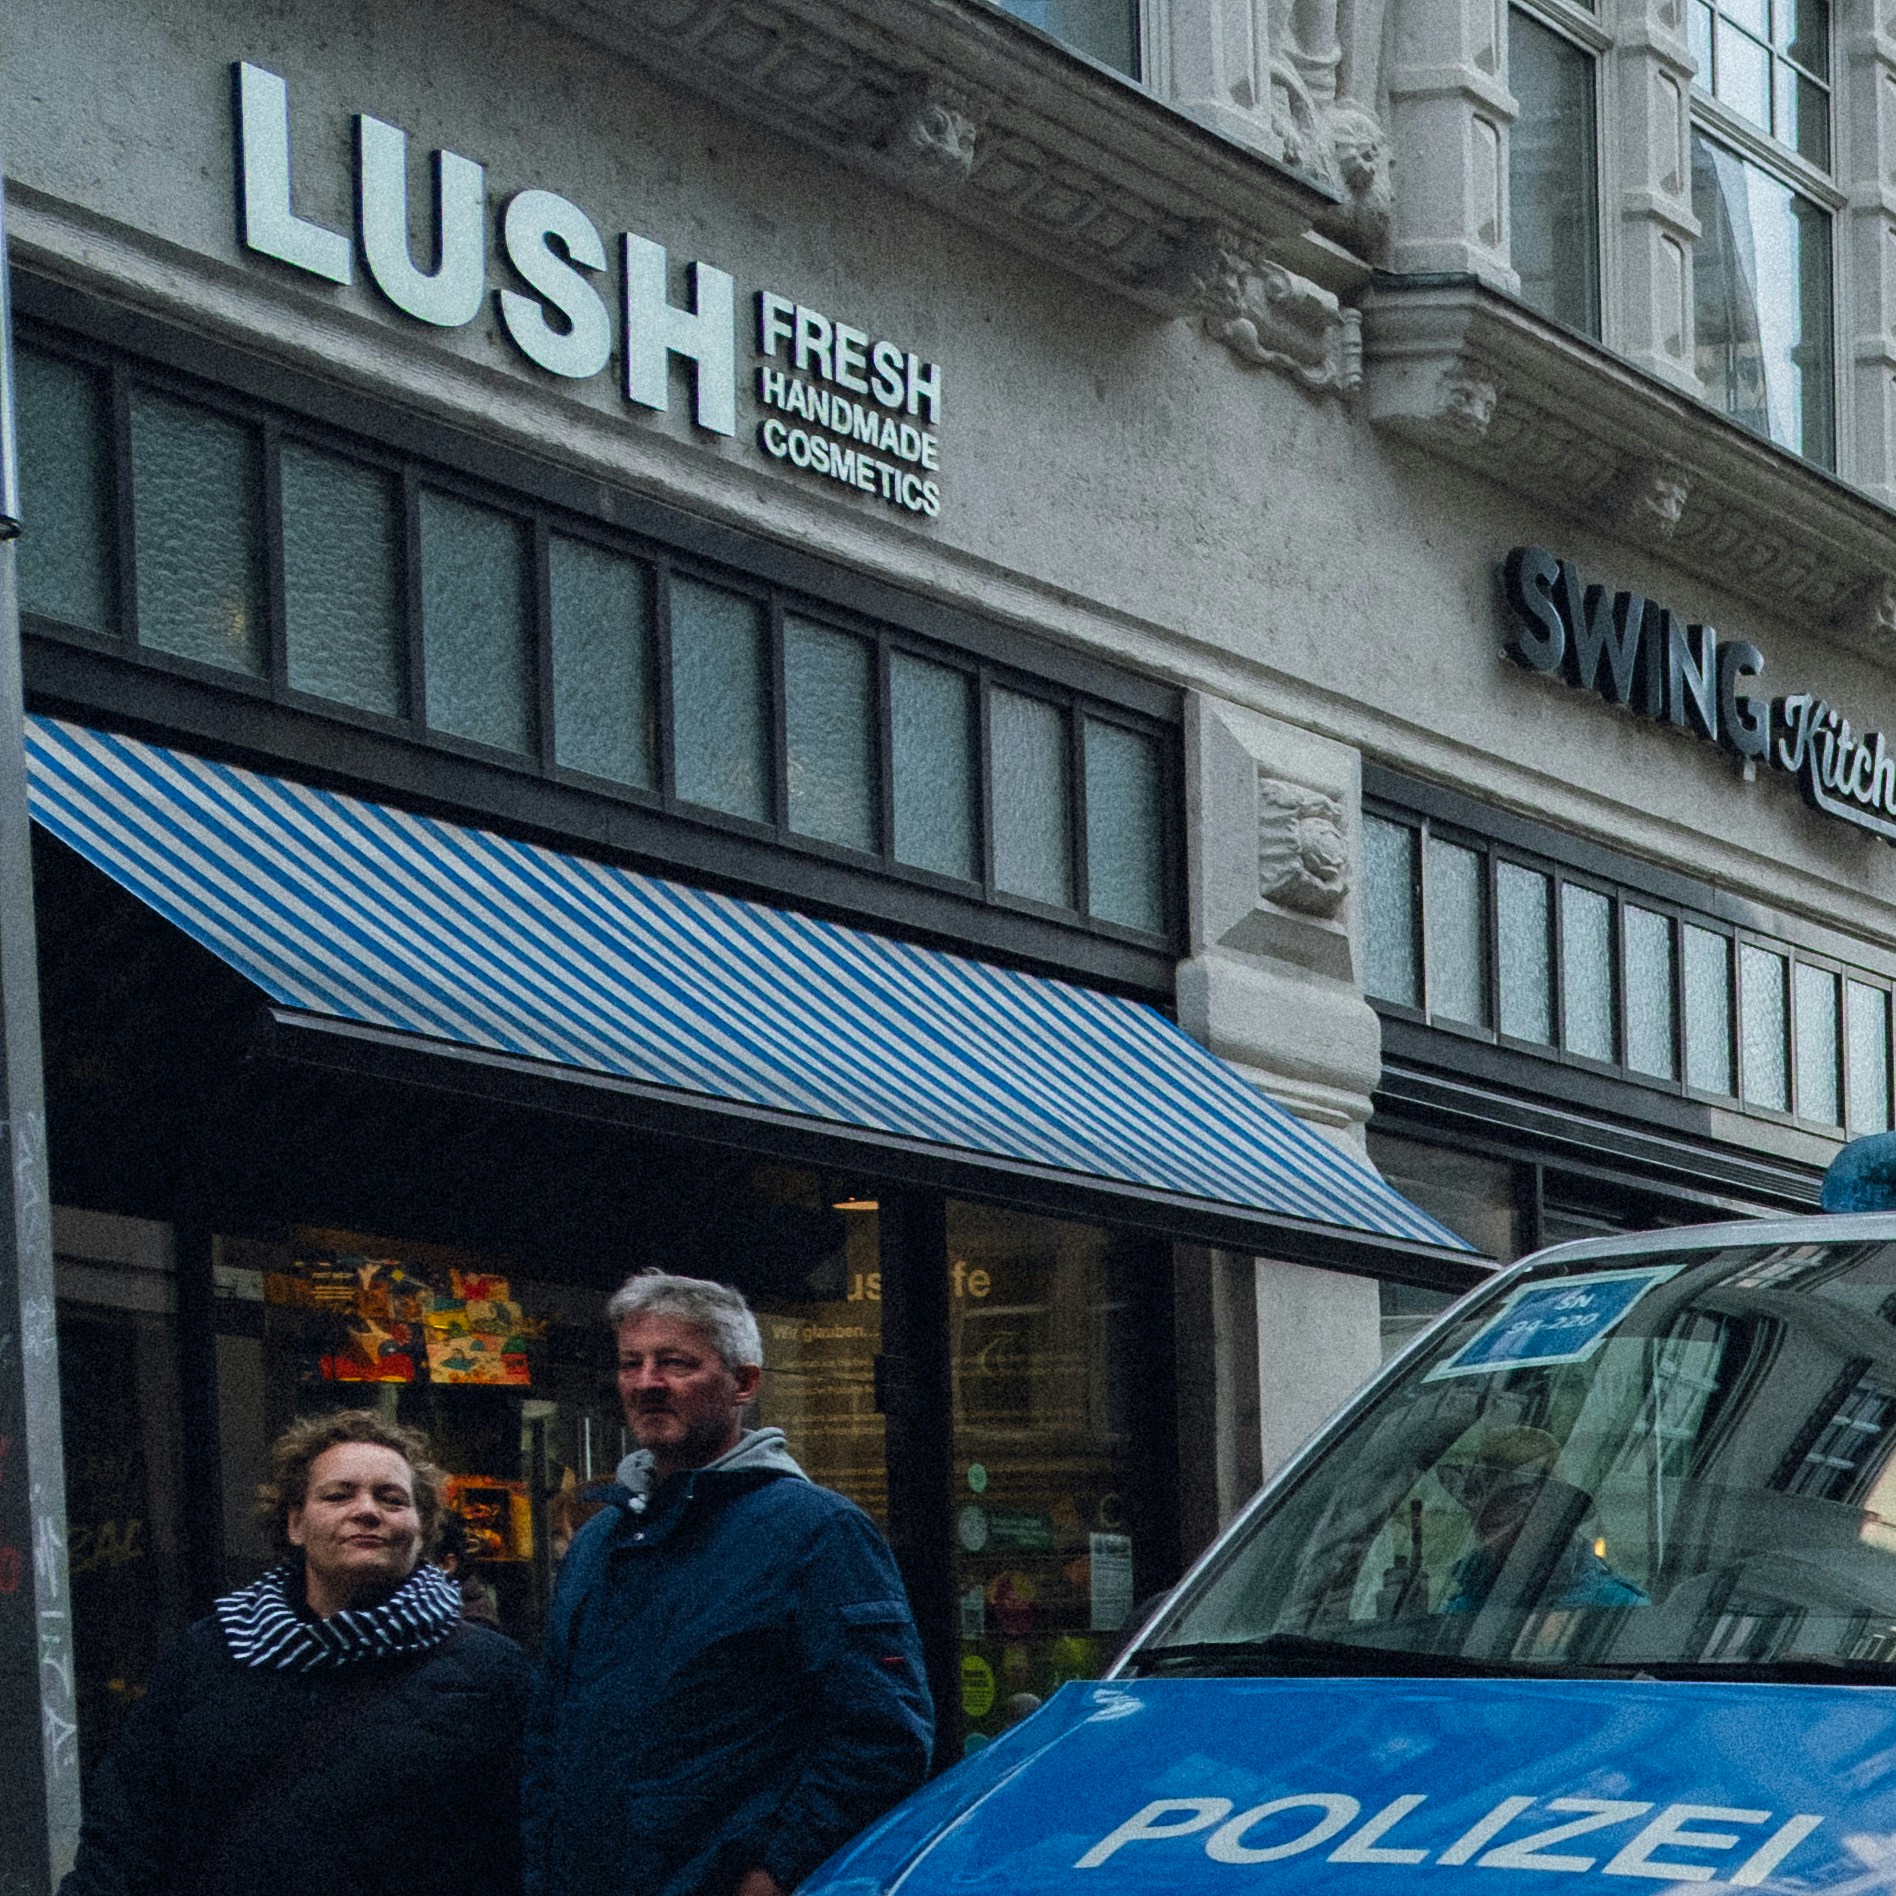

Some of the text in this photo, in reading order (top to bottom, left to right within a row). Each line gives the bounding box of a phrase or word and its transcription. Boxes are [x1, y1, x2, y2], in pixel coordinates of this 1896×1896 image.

[232, 60, 735, 437] LUSH
[756, 290, 942, 425] FRESH
[758, 367, 940, 471] HANDMADE
[760, 419, 941, 517] COSMETICS
[1501, 545, 1770, 761] SWING
[1074, 1793, 1825, 1886] POLIZEI
